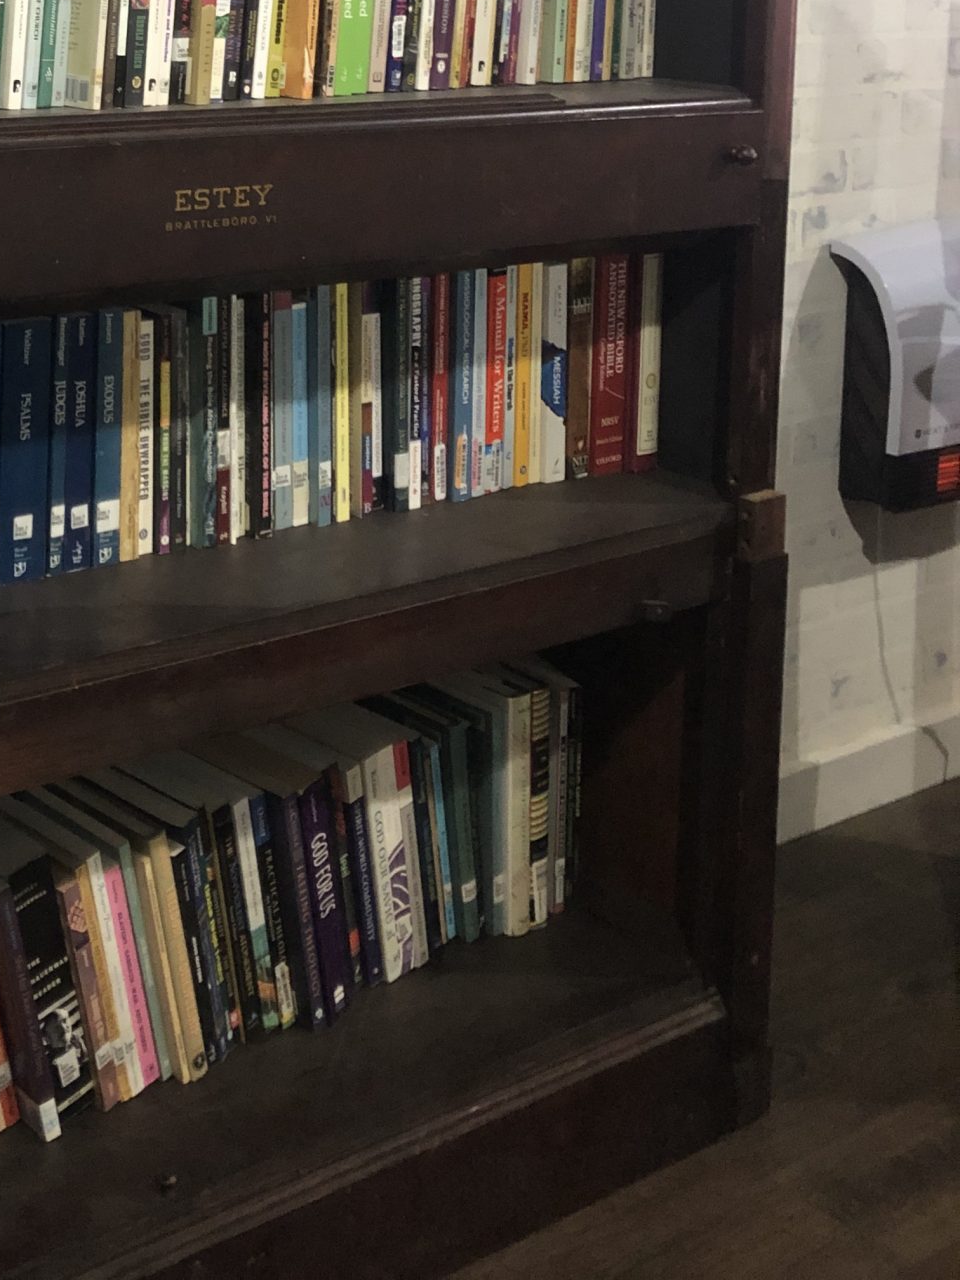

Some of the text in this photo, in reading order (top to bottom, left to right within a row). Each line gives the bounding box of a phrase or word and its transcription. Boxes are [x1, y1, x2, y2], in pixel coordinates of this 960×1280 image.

[175, 184, 273, 212] ESTEY
[165, 215, 257, 232] BRATTLEBORO
[605, 263, 617, 378] ANNOTATED BIBLE
[615, 261, 626, 373] THE NEW OXFORD
[491, 282, 506, 433] A Manual for Writers
[552, 357, 561, 404] MESSIAH
[20, 393, 31, 440] PSALMS
[53, 380, 66, 425] JUDGES
[74, 381, 87, 427] JOSHUA
[103, 375, 115, 424] EXODUS
[139, 378, 149, 500] THE BIBLE UNWRAPPED
[310, 832, 336, 919] GOD FOR US
[377, 848, 390, 879] OUR
